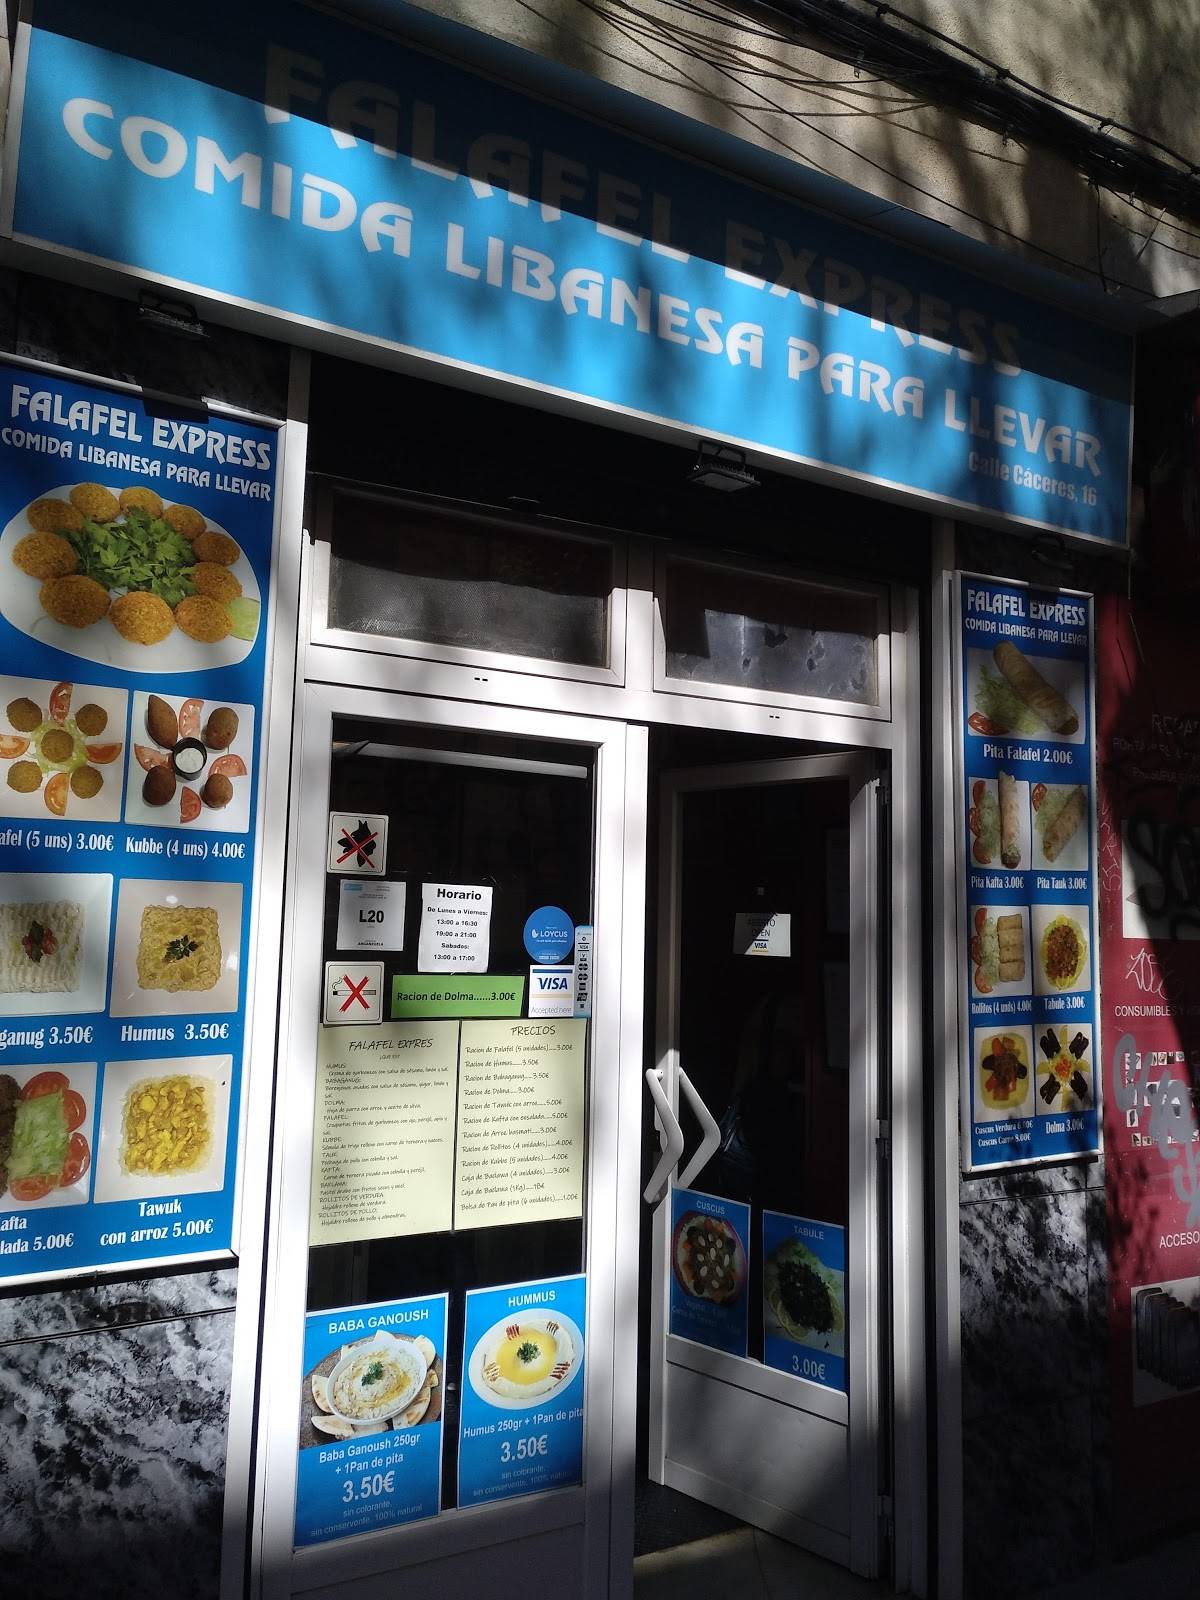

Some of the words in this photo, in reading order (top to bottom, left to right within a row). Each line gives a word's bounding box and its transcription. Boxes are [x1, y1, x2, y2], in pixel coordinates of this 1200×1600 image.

[263, 43, 689, 263] FALAFEL
[724, 218, 1024, 377] EXPRESS
[62, 98, 413, 258] COMIDA
[446, 222, 764, 368] LIBANESA
[787, 336, 924, 418] PARA
[945, 389, 1100, 477] LLEVAR
[11, 384, 142, 442] FALAFEL
[153, 418, 271, 471] EXPRESS
[1, 427, 72, 457] COMIDA
[79, 444, 161, 477] LIBANESA
[166, 462, 210, 487] PARA
[215, 474, 271, 501] LLEVAR
[968, 451, 1010, 482] Calle
[1083, 485, 1097, 506] 16
[968, 589, 1026, 618] FALAFEL
[1030, 600, 1086, 626] EXPRESS
[965, 618, 996, 633] COMIDA
[999, 622, 1036, 639] LIBANESA
[1038, 628, 1058, 642] PARA
[1060, 631, 1088, 648] LLEVAR
[983, 744, 1004, 759] Pita
[1008, 746, 1040, 762] Falafel
[1043, 749, 1073, 764] 2.00€
[26, 830, 40, 851] (5
[44, 833, 72, 852] uns)
[76, 833, 114, 851] 3.00€
[125, 836, 164, 854] Kubbe
[166, 840, 180, 858] (4
[183, 841, 208, 860] uns)
[212, 842, 246, 859] 4.00€
[971, 876, 984, 888] Pita
[986, 876, 1004, 888] Kafta
[1004, 876, 1024, 888] 3.00€
[1037, 877, 1050, 889] Pita
[1068, 878, 1088, 890] 3.00€
[436, 888, 482, 900] Horario
[359, 910, 384, 923] L20
[540, 930, 568, 938] LOYCUS
[536, 977, 568, 990] VISA
[398, 992, 428, 1001] Racion
[430, 992, 442, 1001] de
[1044, 998, 1065, 1010] Tabule
[1066, 996, 1086, 1009] 3.00€
[50, 1026, 94, 1045] 3.50€
[120, 1025, 175, 1042] Humus
[184, 1023, 230, 1040] 3.50€
[511, 1026, 556, 1036] PRECIOS
[349, 1040, 394, 1052] FALAFEL
[1046, 1122, 1065, 1134] Dolma
[138, 1200, 182, 1217] Tawuk
[696, 1200, 725, 1214] CUSCUS
[0, 1216, 28, 1231] afta
[100, 1231, 126, 1246] con
[131, 1226, 168, 1242] arroz
[172, 1219, 214, 1238] 5.00€
[793, 1224, 824, 1240] TABULE
[33, 1233, 74, 1250] 5.00€
[508, 1290, 556, 1307] HUMMUS
[328, 1320, 364, 1334] BABA
[368, 1309, 429, 1329] GANOUSH
[792, 1354, 826, 1380] 3.00€
[464, 1425, 496, 1438] Humus
[498, 1419, 523, 1433] 250gr
[532, 1414, 553, 1425] 1Pan
[556, 1411, 566, 1420] de
[319, 1452, 345, 1464] Baba
[347, 1441, 391, 1459] Ganoush
[393, 1433, 421, 1450] 250gr
[500, 1435, 548, 1462] 3.50€
[344, 1460, 368, 1472] 1Pan
[370, 1457, 383, 1467] de
[386, 1453, 404, 1467] pita
[342, 1470, 395, 1502] 3.50€
